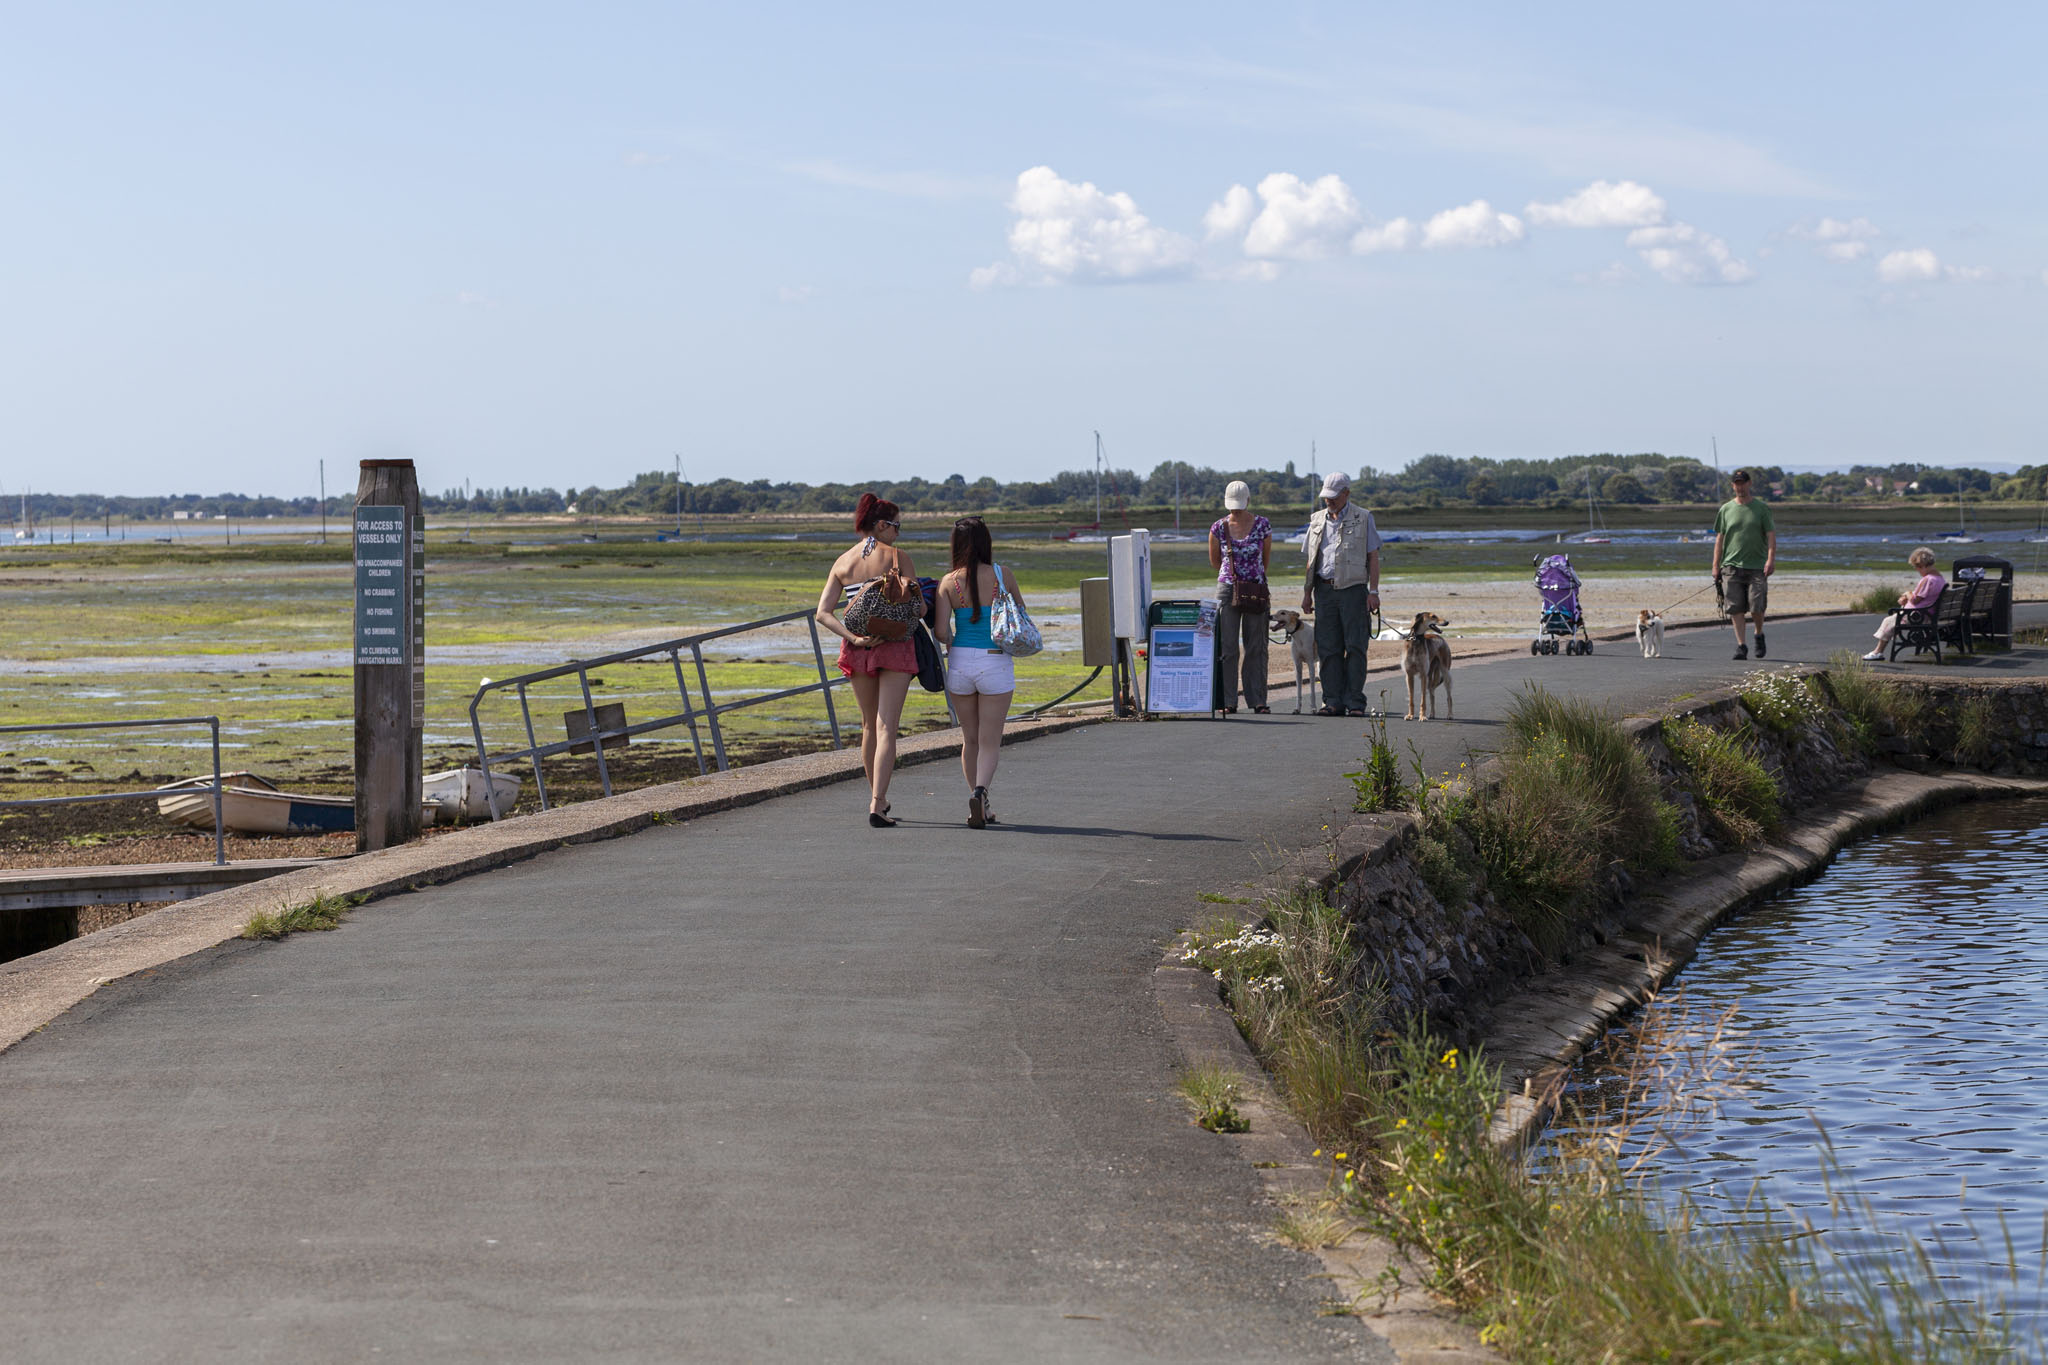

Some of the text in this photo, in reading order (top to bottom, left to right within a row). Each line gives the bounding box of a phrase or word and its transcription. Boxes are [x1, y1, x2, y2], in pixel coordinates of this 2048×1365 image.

[357, 521, 402, 530] FOR ACCESS TO
[358, 534, 402, 544] VESSELS ONLY
[358, 656, 402, 664] NAVIGATION MARKS
